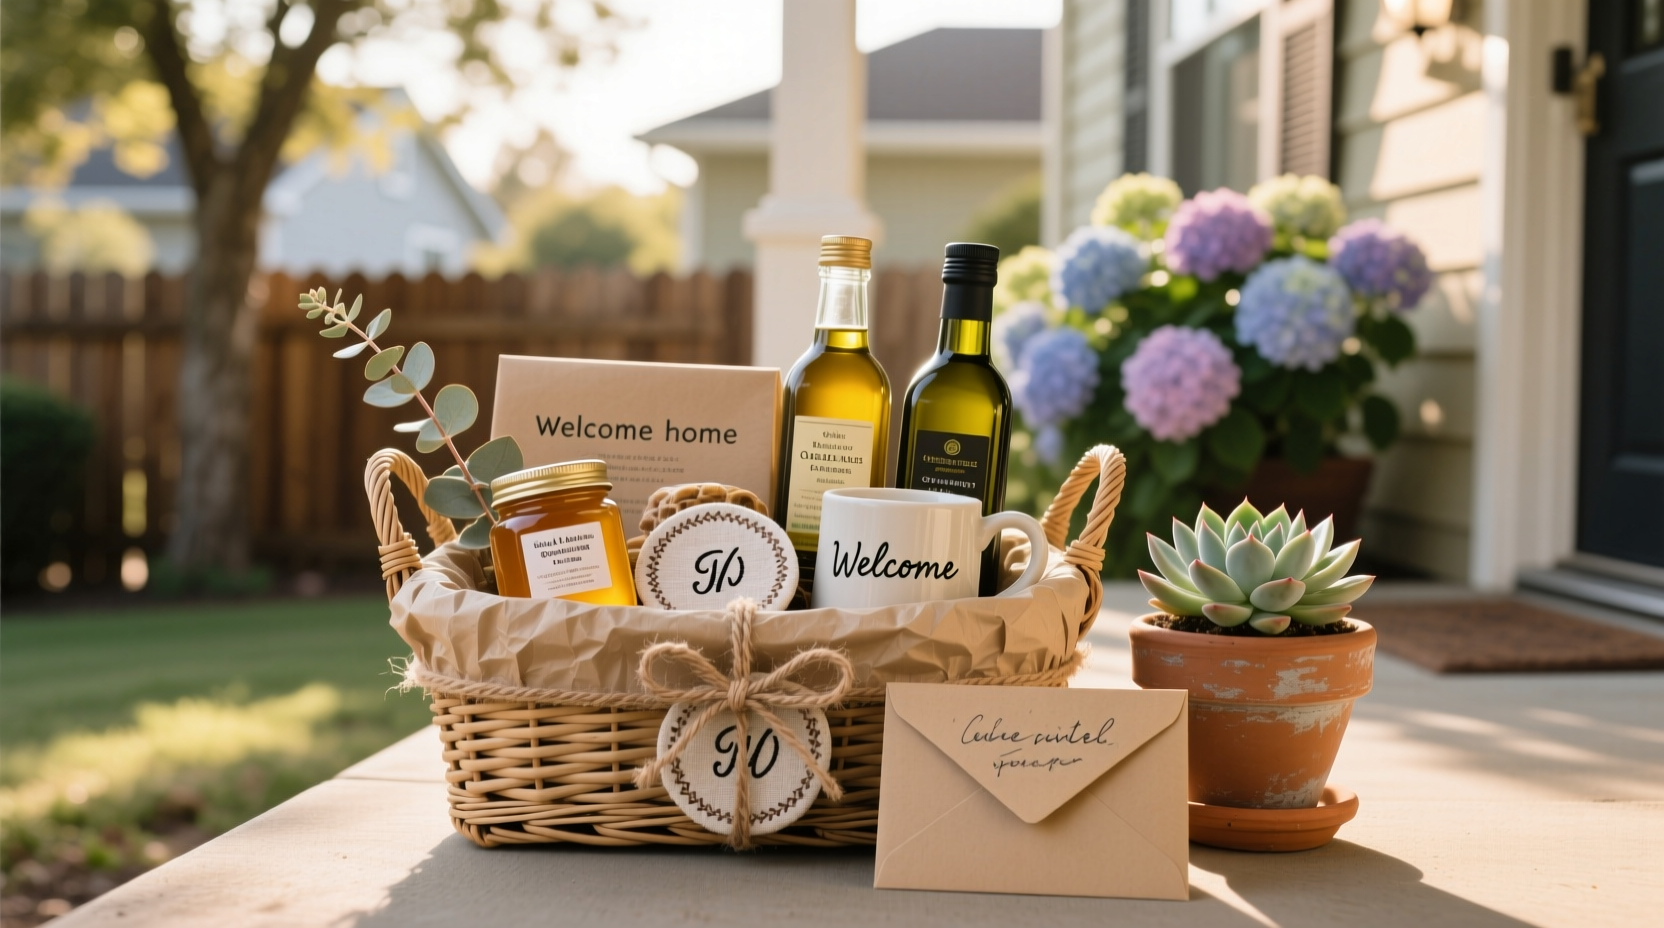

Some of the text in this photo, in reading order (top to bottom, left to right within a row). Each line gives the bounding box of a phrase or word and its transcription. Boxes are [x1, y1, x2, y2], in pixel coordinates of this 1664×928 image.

[536, 414, 738, 445] Welcome home
[833, 540, 959, 579] Welcome
